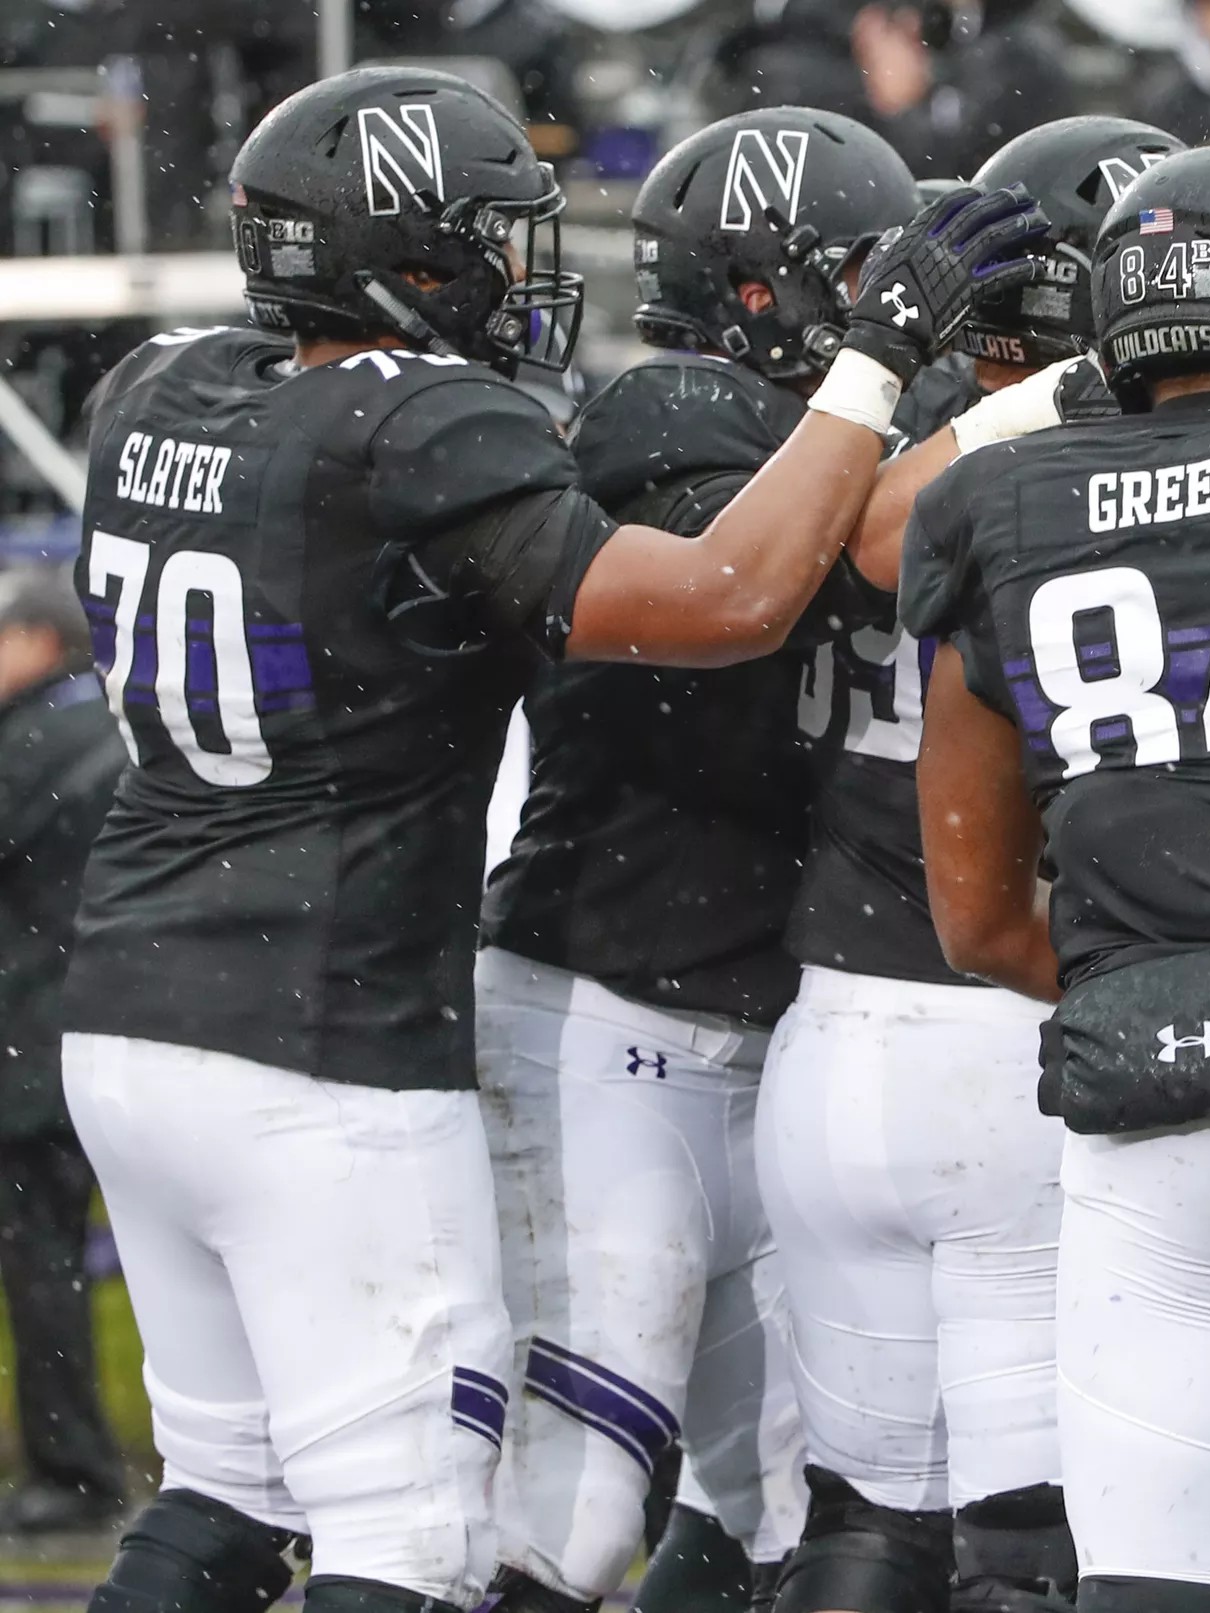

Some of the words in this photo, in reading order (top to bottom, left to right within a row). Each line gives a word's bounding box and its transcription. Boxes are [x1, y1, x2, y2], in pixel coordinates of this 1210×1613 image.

[357, 103, 445, 217] N
[719, 129, 810, 232] N
[1120, 242, 1191, 306] 84
[116, 431, 232, 514] SLATER
[89, 529, 274, 788] 70
